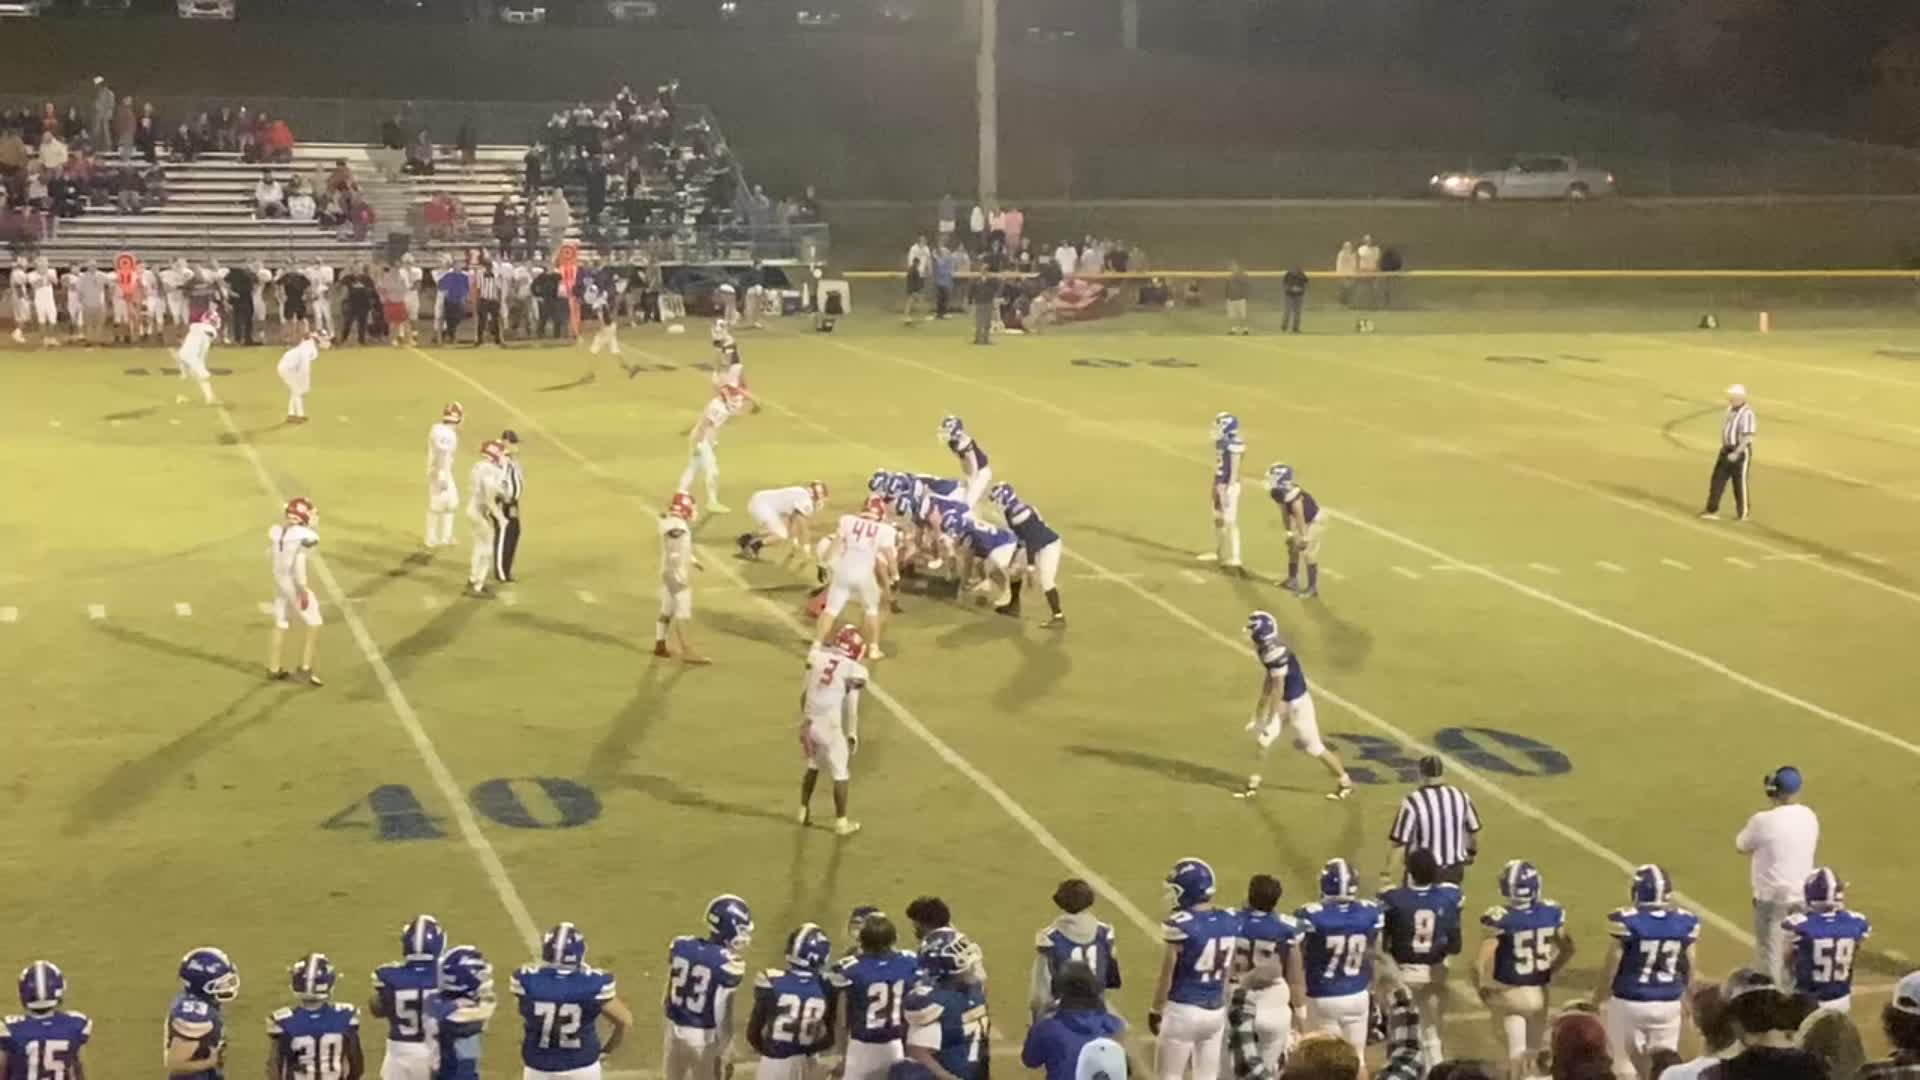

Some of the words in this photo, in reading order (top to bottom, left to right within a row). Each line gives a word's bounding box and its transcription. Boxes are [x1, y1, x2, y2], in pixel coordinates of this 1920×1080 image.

[852, 520, 879, 542] 44
[820, 659, 840, 686] 3
[320, 776, 604, 841] 40
[1193, 935, 1236, 983] 47
[1513, 927, 1556, 975] 55
[1638, 940, 1681, 983] 73
[1812, 937, 1853, 983] 59
[670, 957, 711, 1014] 23
[866, 979, 905, 1028] 21
[534, 1000, 583, 1049] 72
[25, 1039, 70, 1080] 15
[290, 1033, 344, 1080] 30
